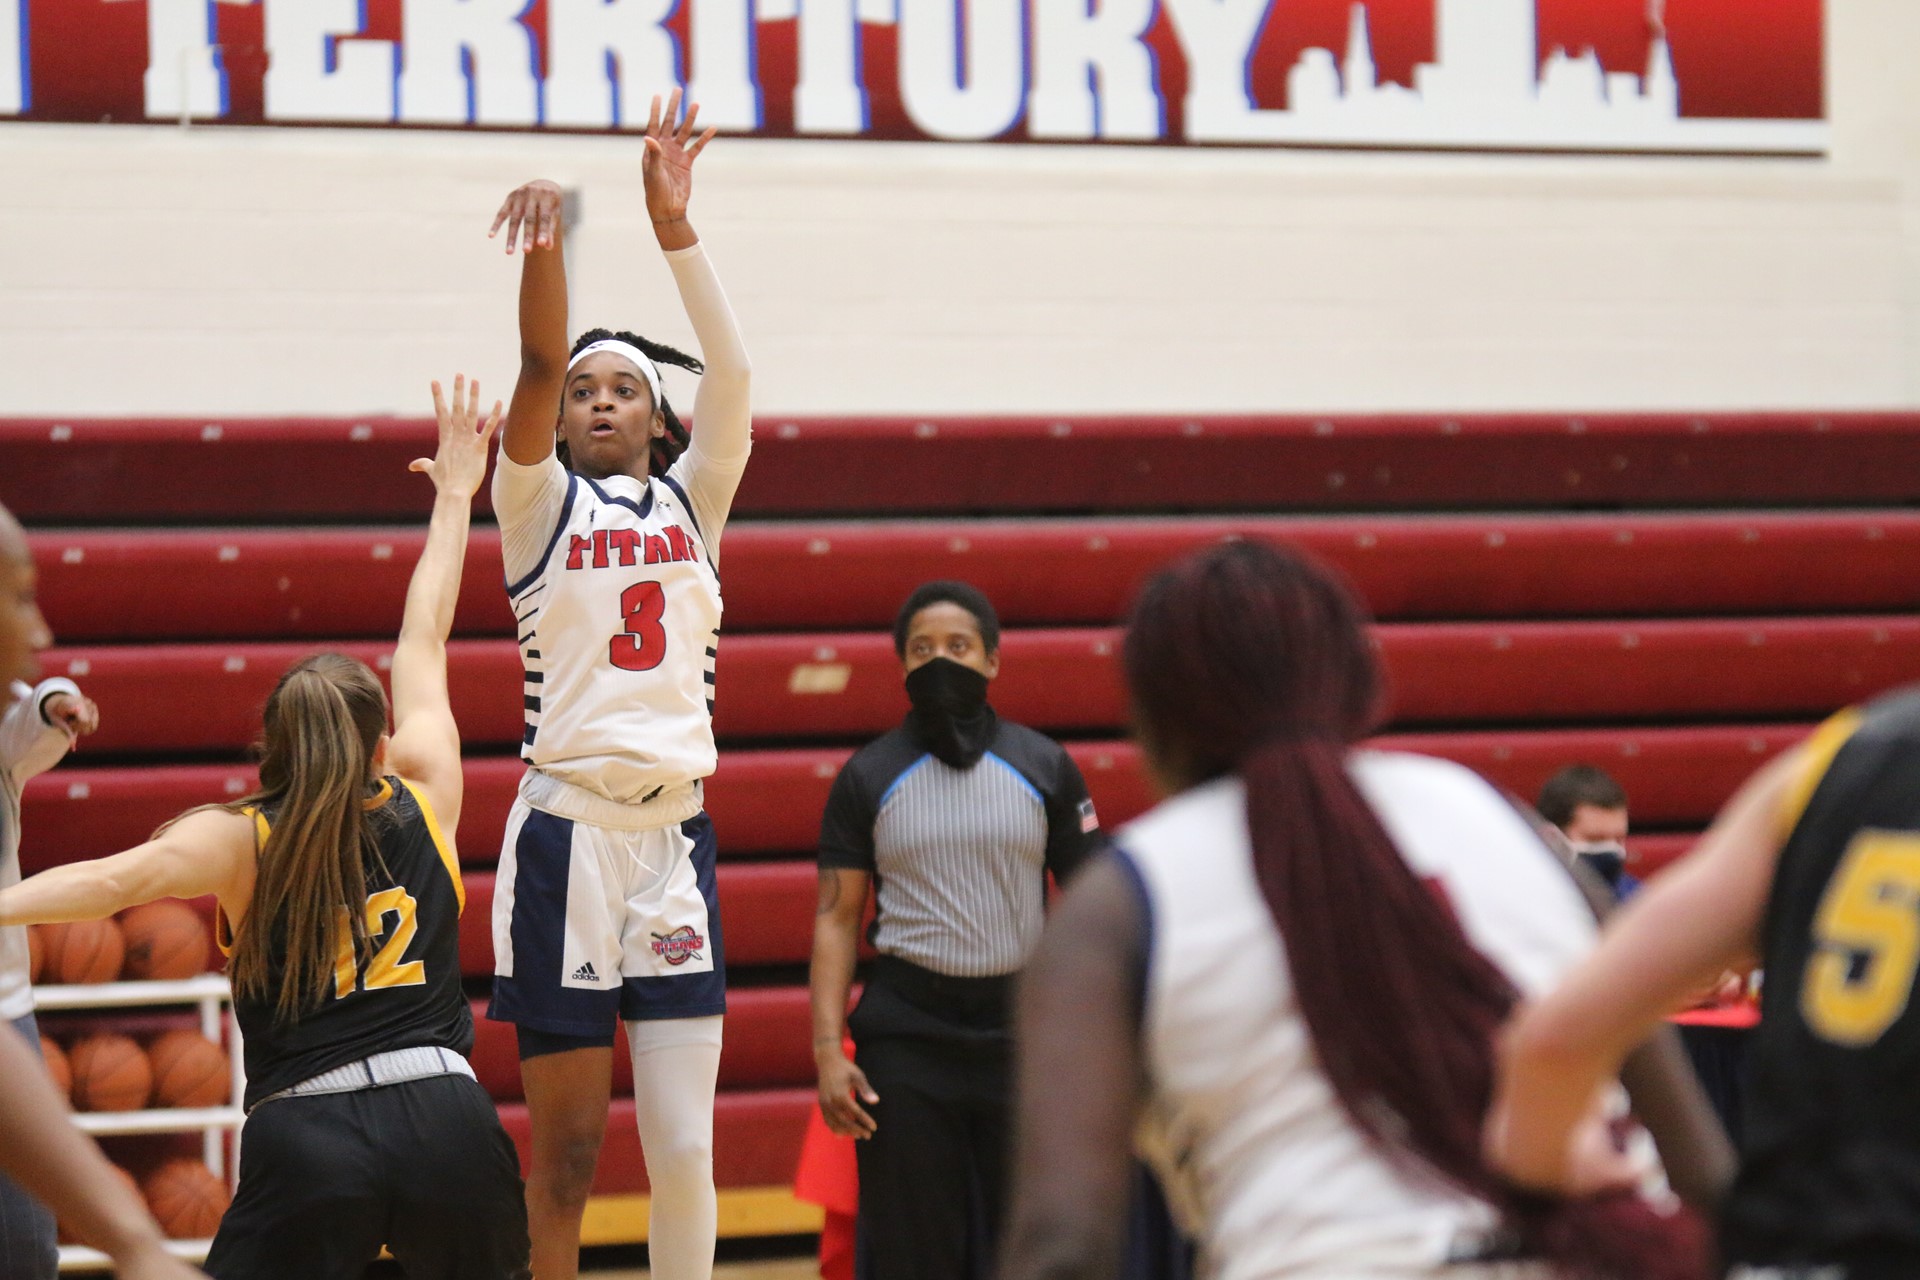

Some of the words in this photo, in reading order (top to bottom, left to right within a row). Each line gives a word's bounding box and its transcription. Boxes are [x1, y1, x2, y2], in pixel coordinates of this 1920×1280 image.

[609, 580, 667, 671] 3
[333, 886, 426, 999] 12
[652, 935, 704, 956] TITANS
[572, 973, 600, 982] adidas
